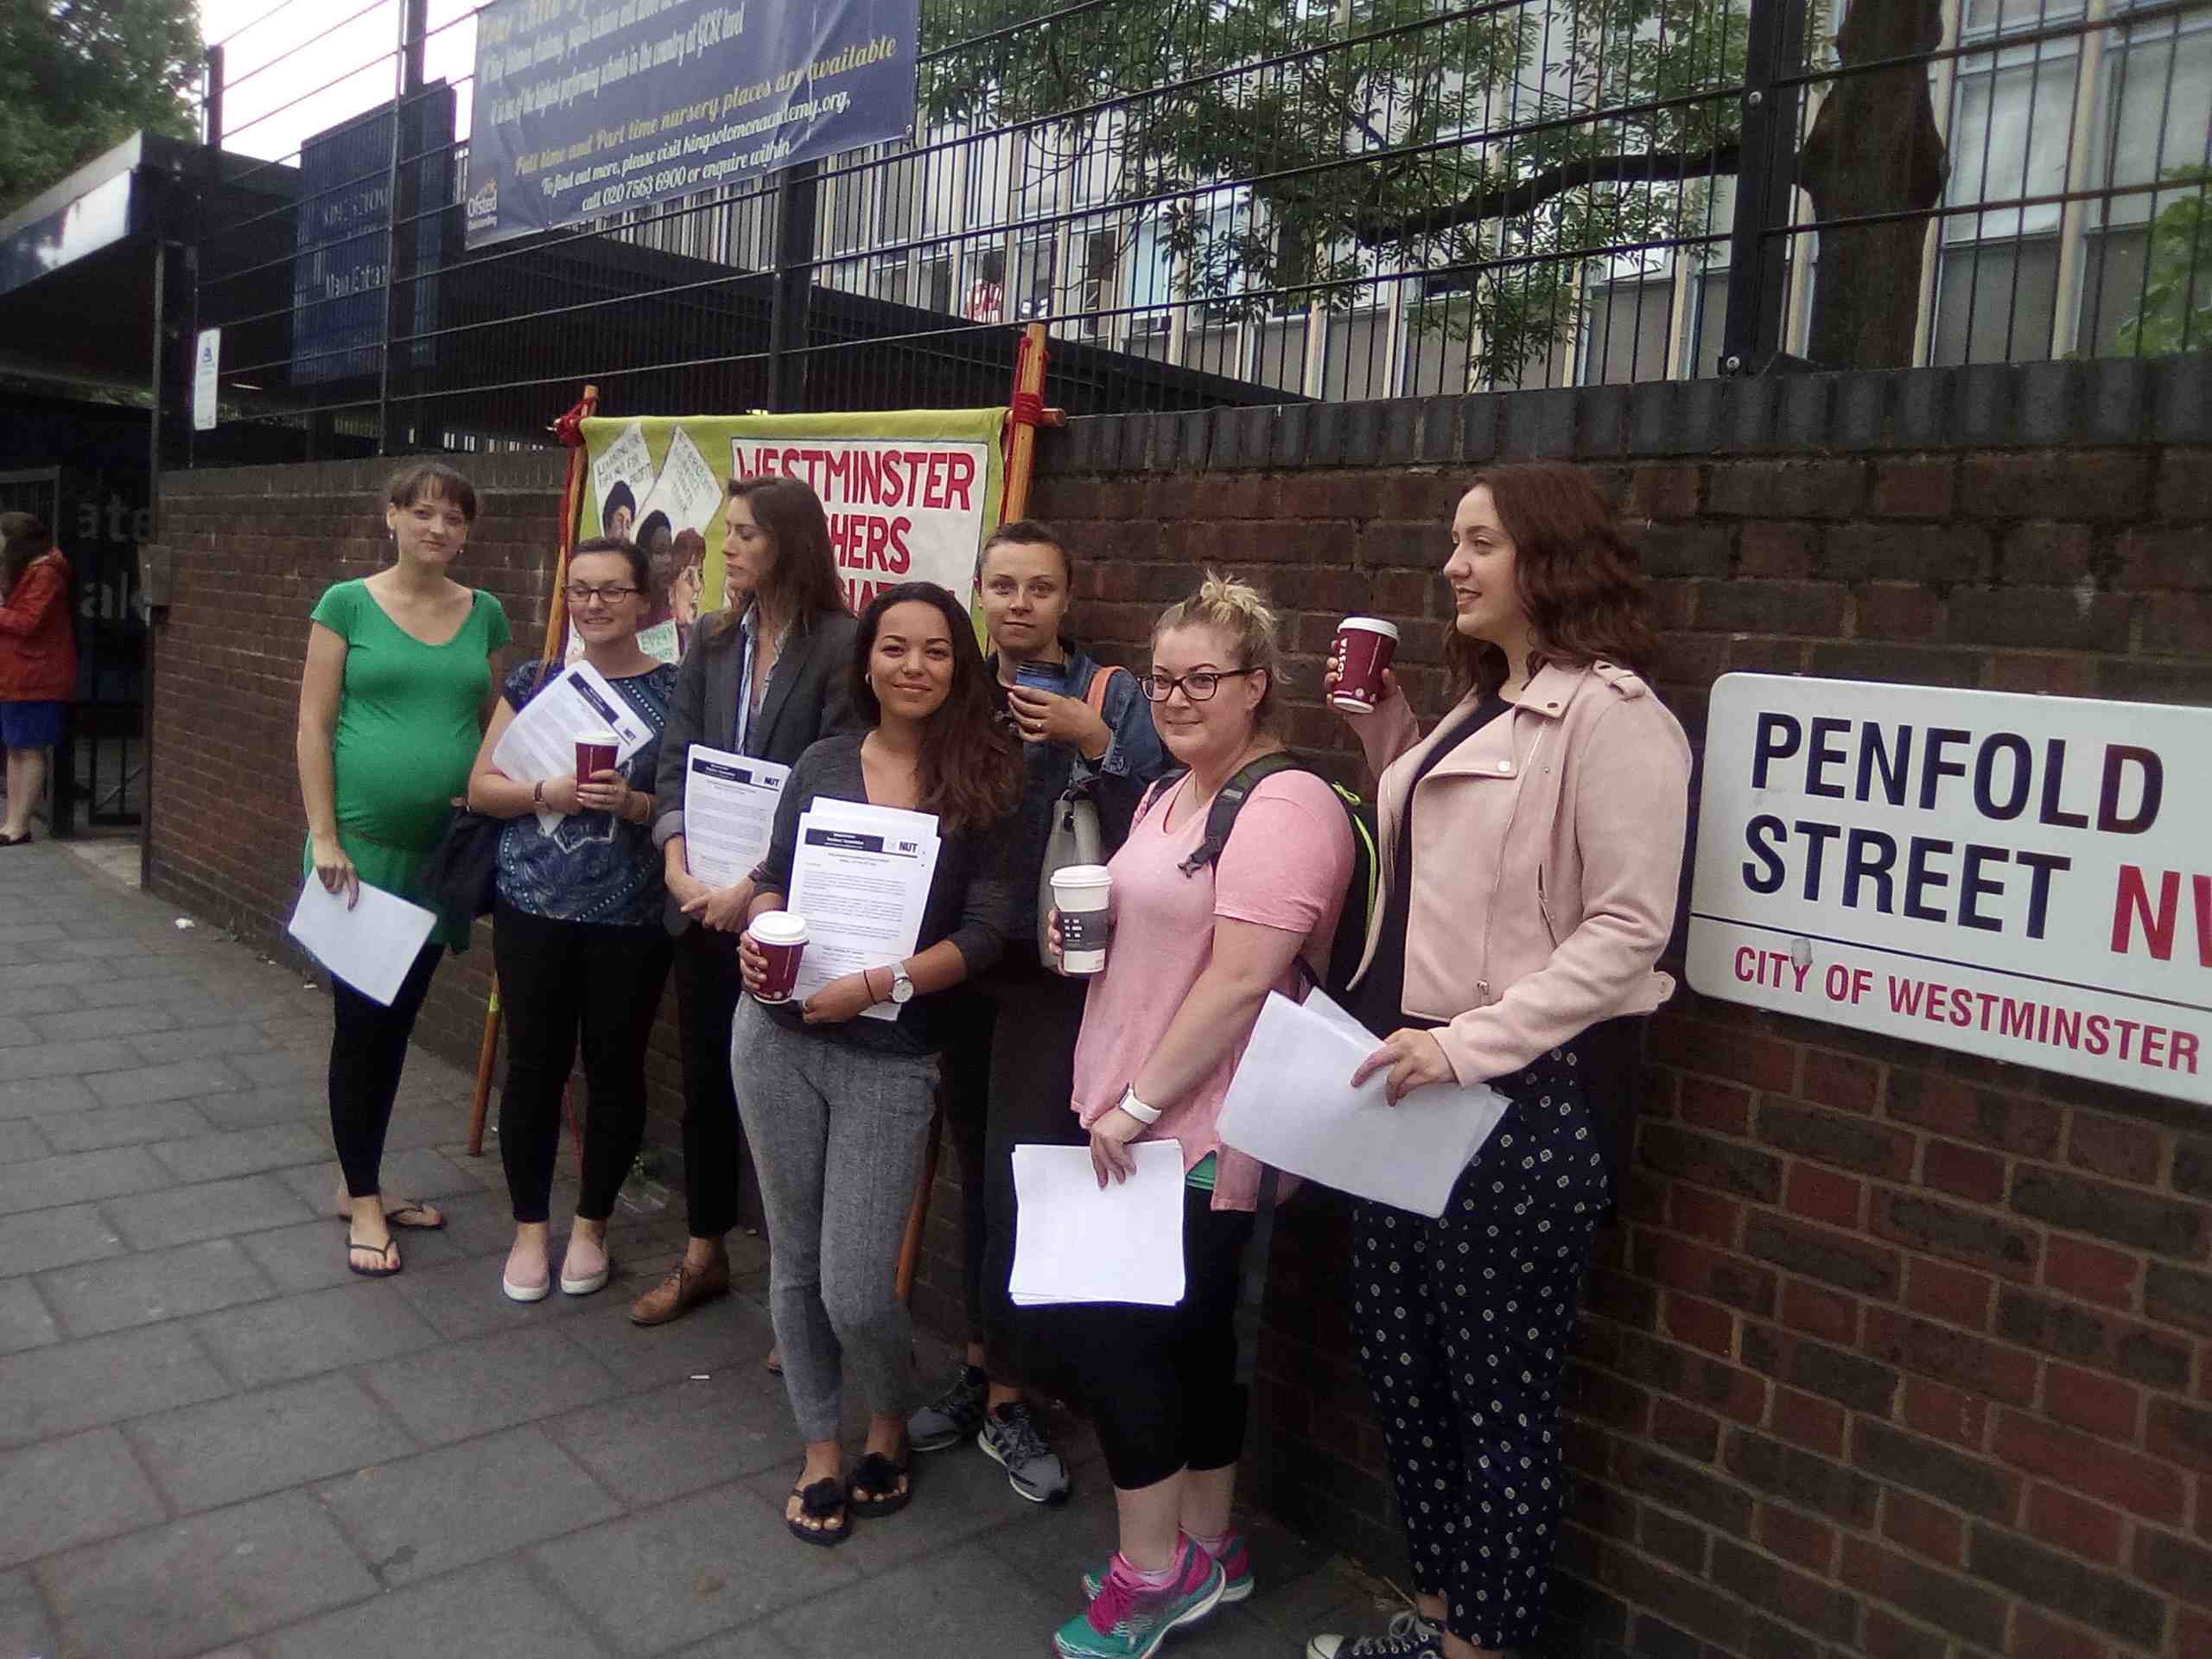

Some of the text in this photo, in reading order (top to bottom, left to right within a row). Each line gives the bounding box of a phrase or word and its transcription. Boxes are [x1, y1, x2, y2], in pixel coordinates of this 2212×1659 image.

[569, 135, 593, 156] and
[596, 124, 625, 151] Part
[628, 117, 659, 141] time
[662, 98, 719, 130] nursery
[721, 79, 771, 118] places
[775, 68, 804, 92] are
[806, 34, 896, 81] available
[582, 137, 790, 211] call 020 7563 6900 or enquire within
[621, 152, 656, 177] please
[658, 138, 681, 162] visit
[467, 192, 498, 218] Ofsted
[830, 513, 912, 575] HERS
[1751, 711, 2164, 835] PENFOLD
[899, 841, 918, 853] NUT
[1741, 814, 2212, 969] STREET N
[1734, 946, 2201, 1074] CITY OF WESTMINSTER
